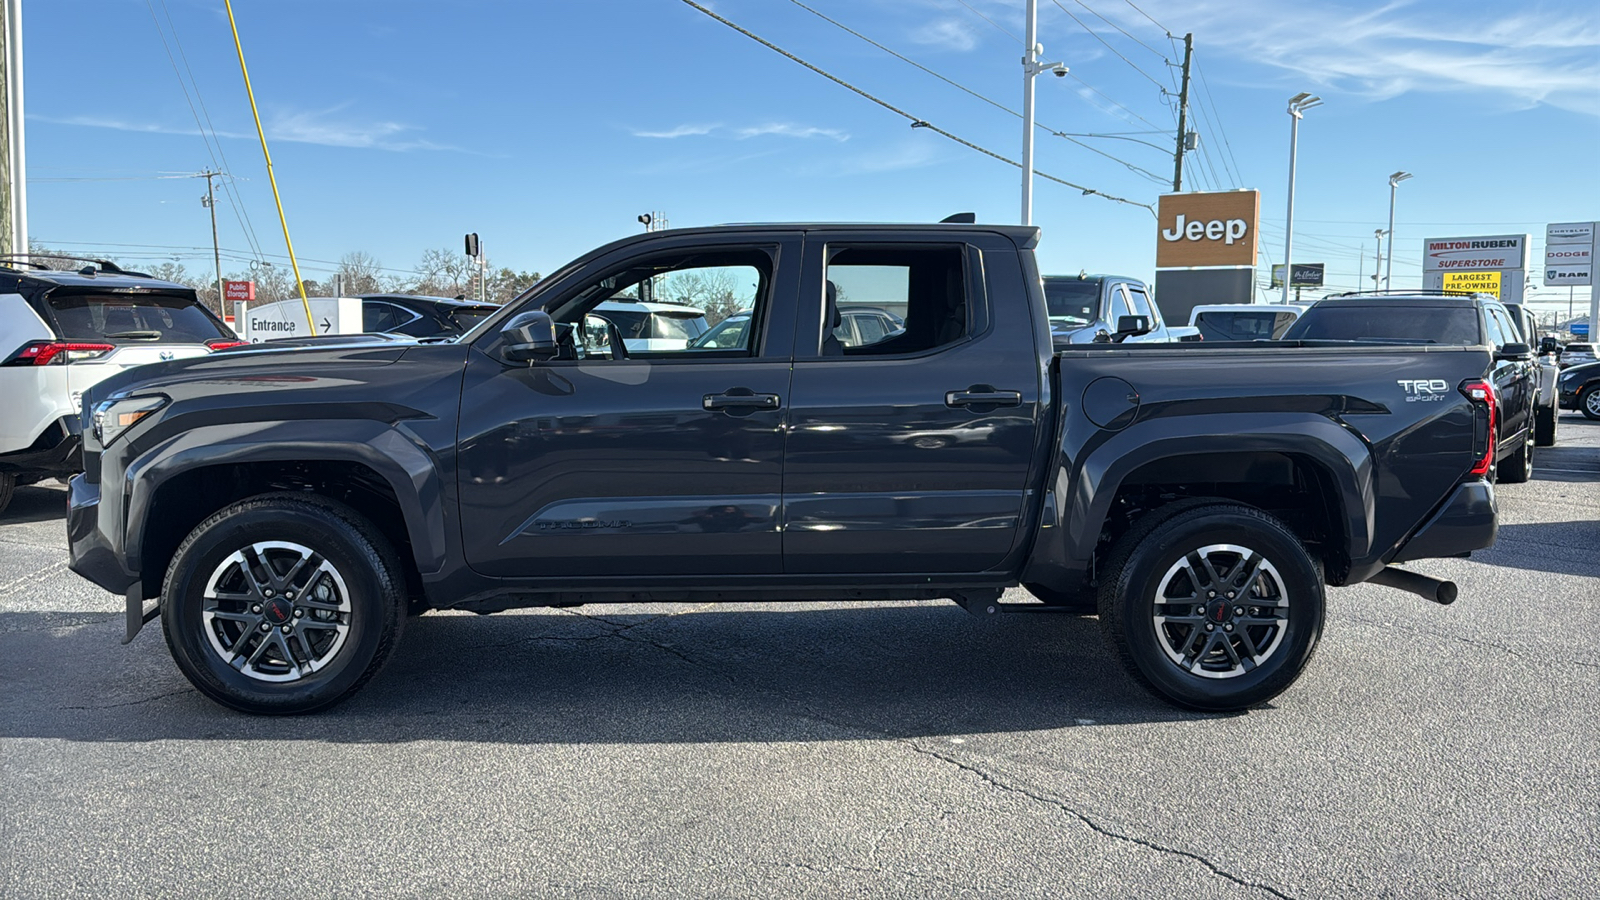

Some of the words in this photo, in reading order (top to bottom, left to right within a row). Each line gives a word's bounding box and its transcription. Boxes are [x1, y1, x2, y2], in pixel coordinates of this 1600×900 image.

[1162, 214, 1248, 245] Jeep
[1429, 241, 1471, 251] MILTON
[1471, 240, 1517, 249] RUBEN
[1438, 259, 1505, 268] SUPERSTORE
[228, 283, 247, 291] Public
[1445, 282, 1498, 290] PRE-OWNED
[227, 291, 248, 299] Storage
[252, 317, 296, 332] Entrance
[1397, 379, 1449, 394] TRD
[533, 519, 632, 530] TACOMA
